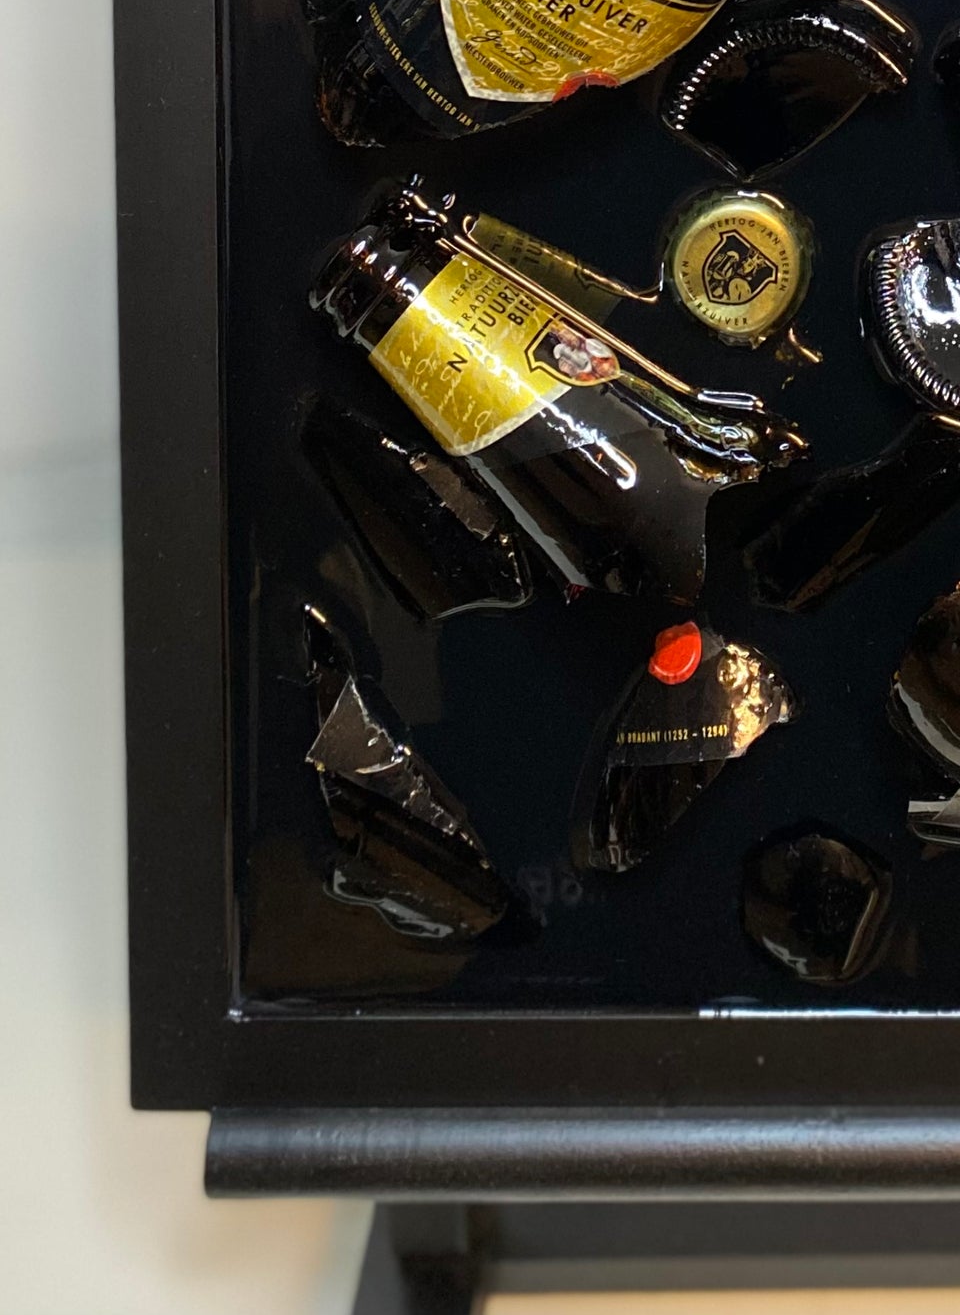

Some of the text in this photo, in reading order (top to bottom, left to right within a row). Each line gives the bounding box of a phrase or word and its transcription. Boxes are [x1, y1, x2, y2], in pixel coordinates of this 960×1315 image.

[505, 15, 517, 30] EN
[533, 10, 581, 44] GEBROUWEN
[389, 42, 402, 62] TER
[412, 73, 428, 91] VAN
[709, 218, 790, 292] HERTOG JAN BIEREN
[449, 269, 483, 305] HERTOG
[457, 277, 501, 328] TRADITIO
[627, 730, 661, 744] BRABANT
[663, 728, 689, 742] (1252
[702, 724, 729, 739] 1294)
